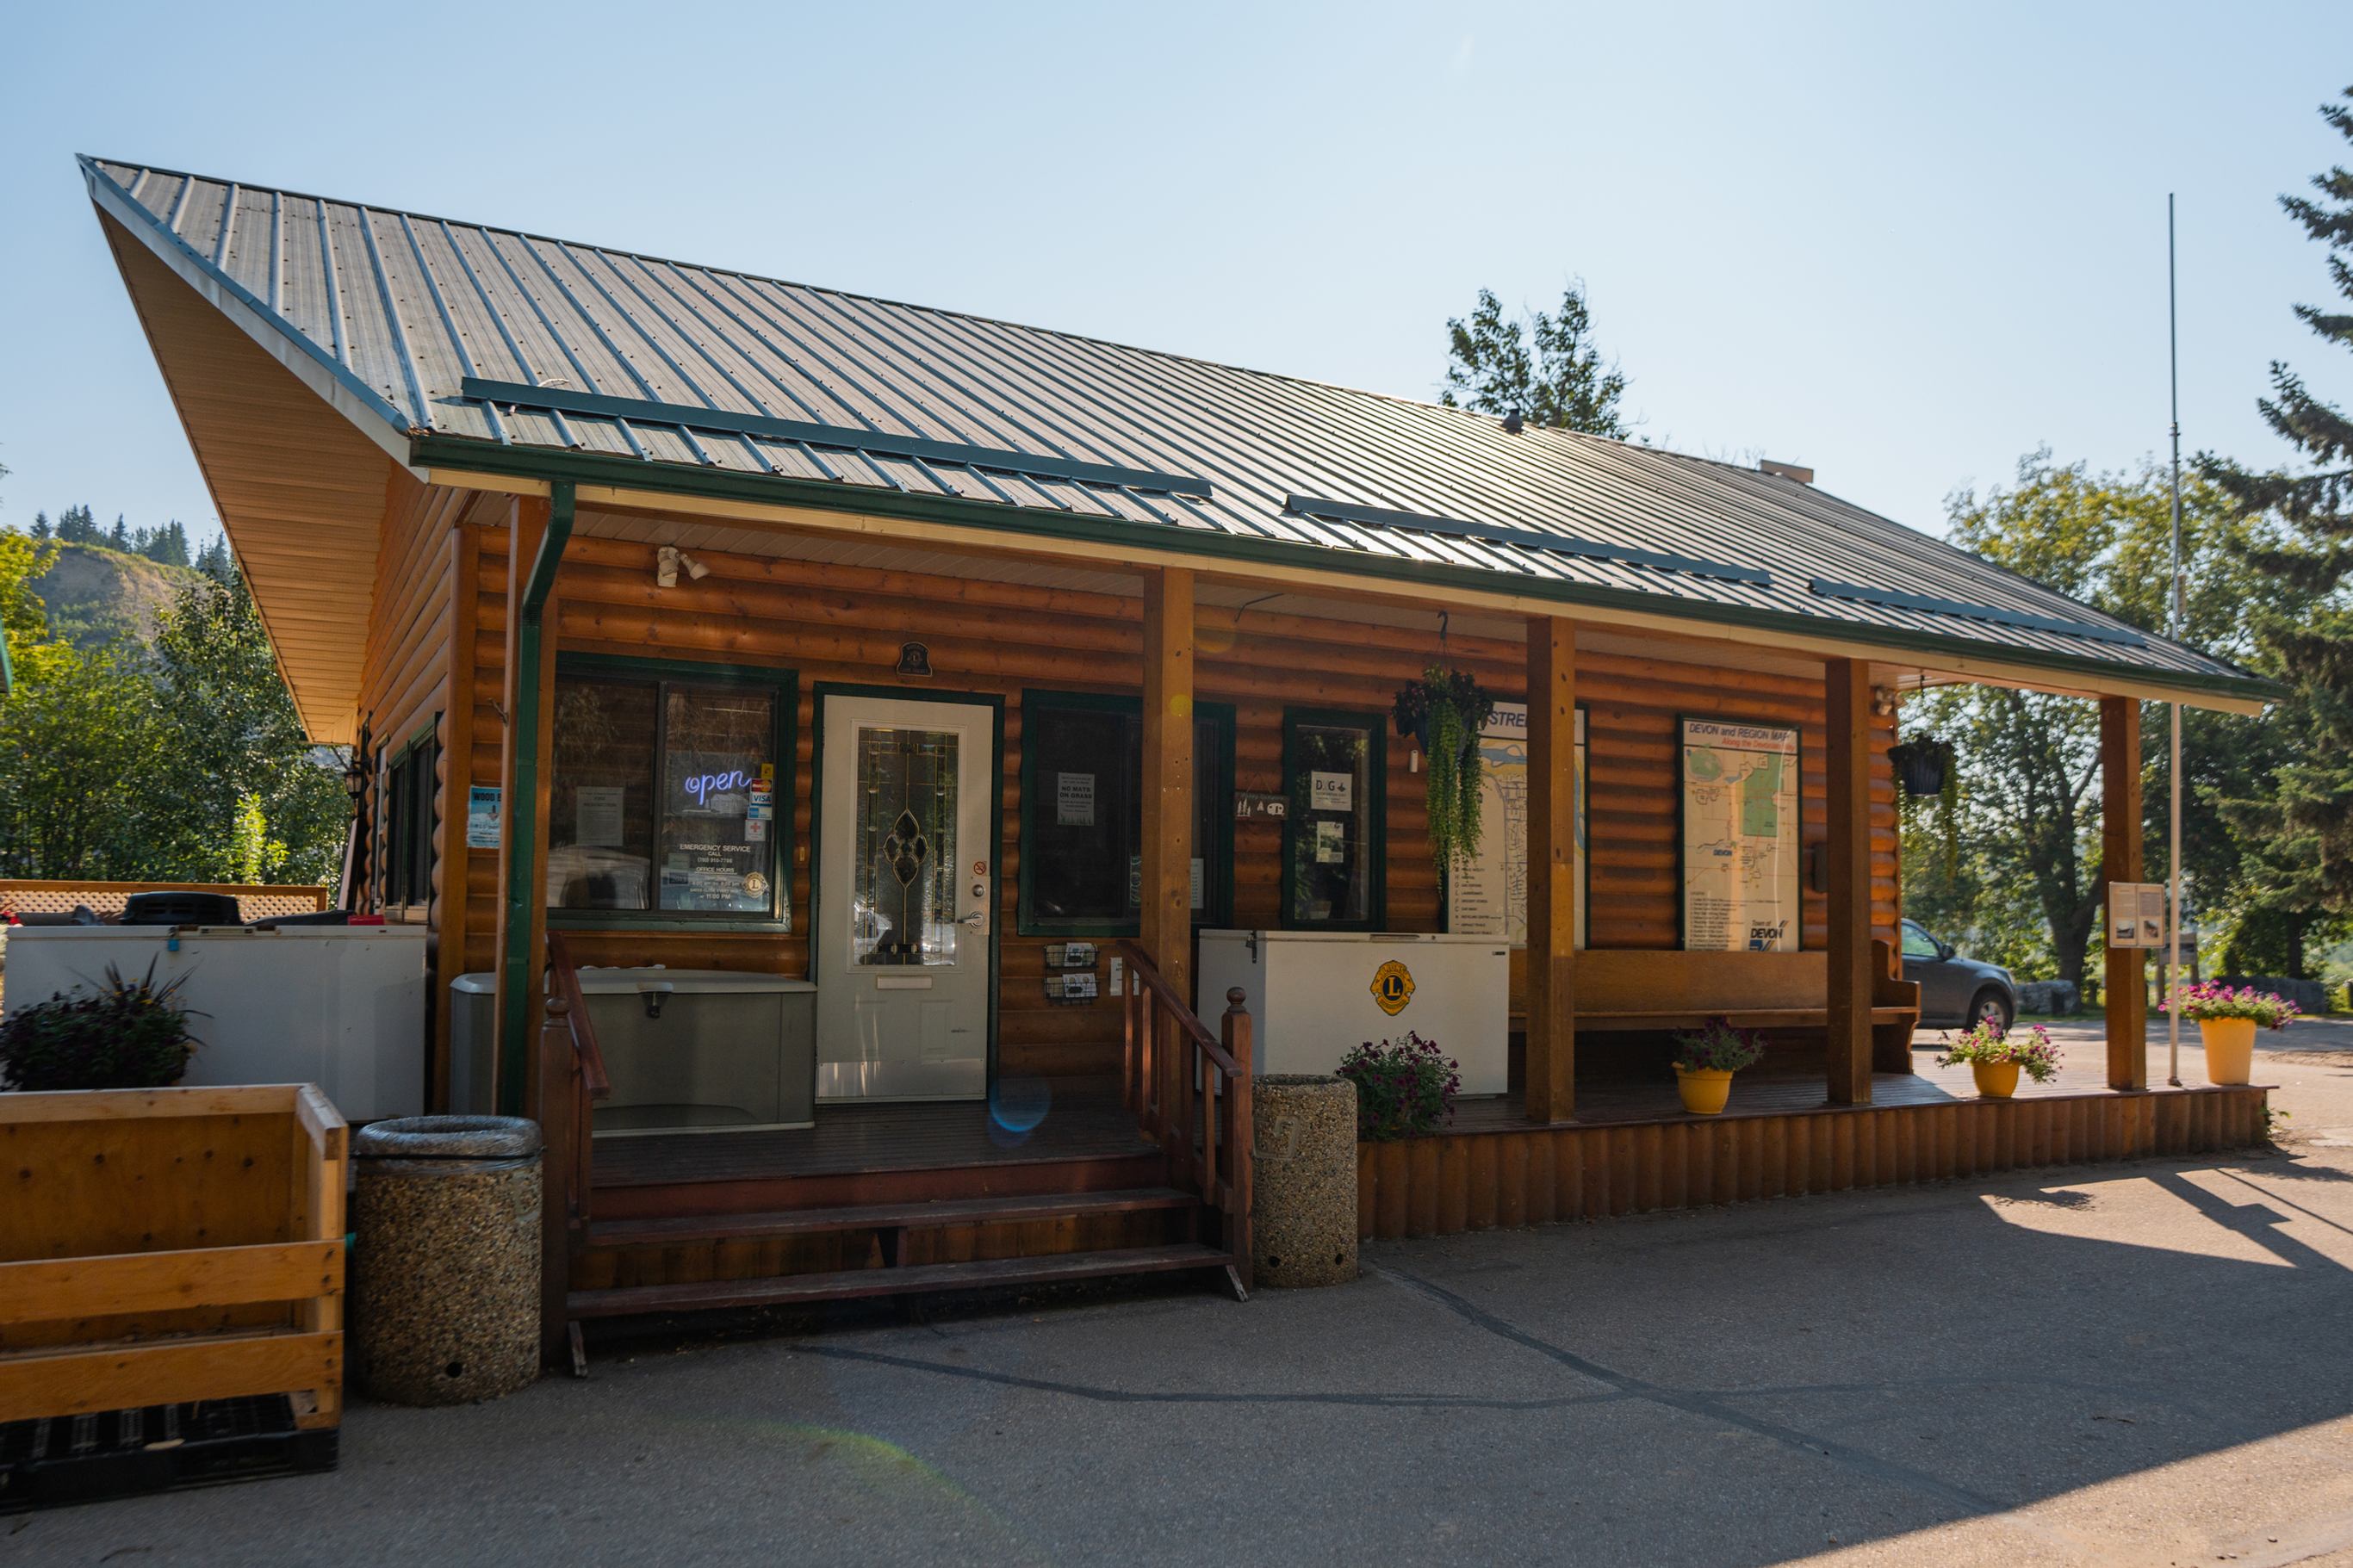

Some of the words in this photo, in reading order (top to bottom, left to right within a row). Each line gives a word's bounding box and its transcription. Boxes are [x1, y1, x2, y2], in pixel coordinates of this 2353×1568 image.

[1489, 711, 1528, 728] STRE
[1689, 723, 1719, 735] DEVON
[1721, 728, 1736, 737] and
[1738, 728, 1769, 740] REGION
[1772, 731, 1791, 741] MAP
[685, 770, 752, 805] open
[474, 792, 495, 802] WOOD
[680, 843, 721, 852] EMERGENCY
[751, 879, 758, 889] L
[1750, 928, 1783, 939] DEVON
[1387, 976, 1401, 996] L
